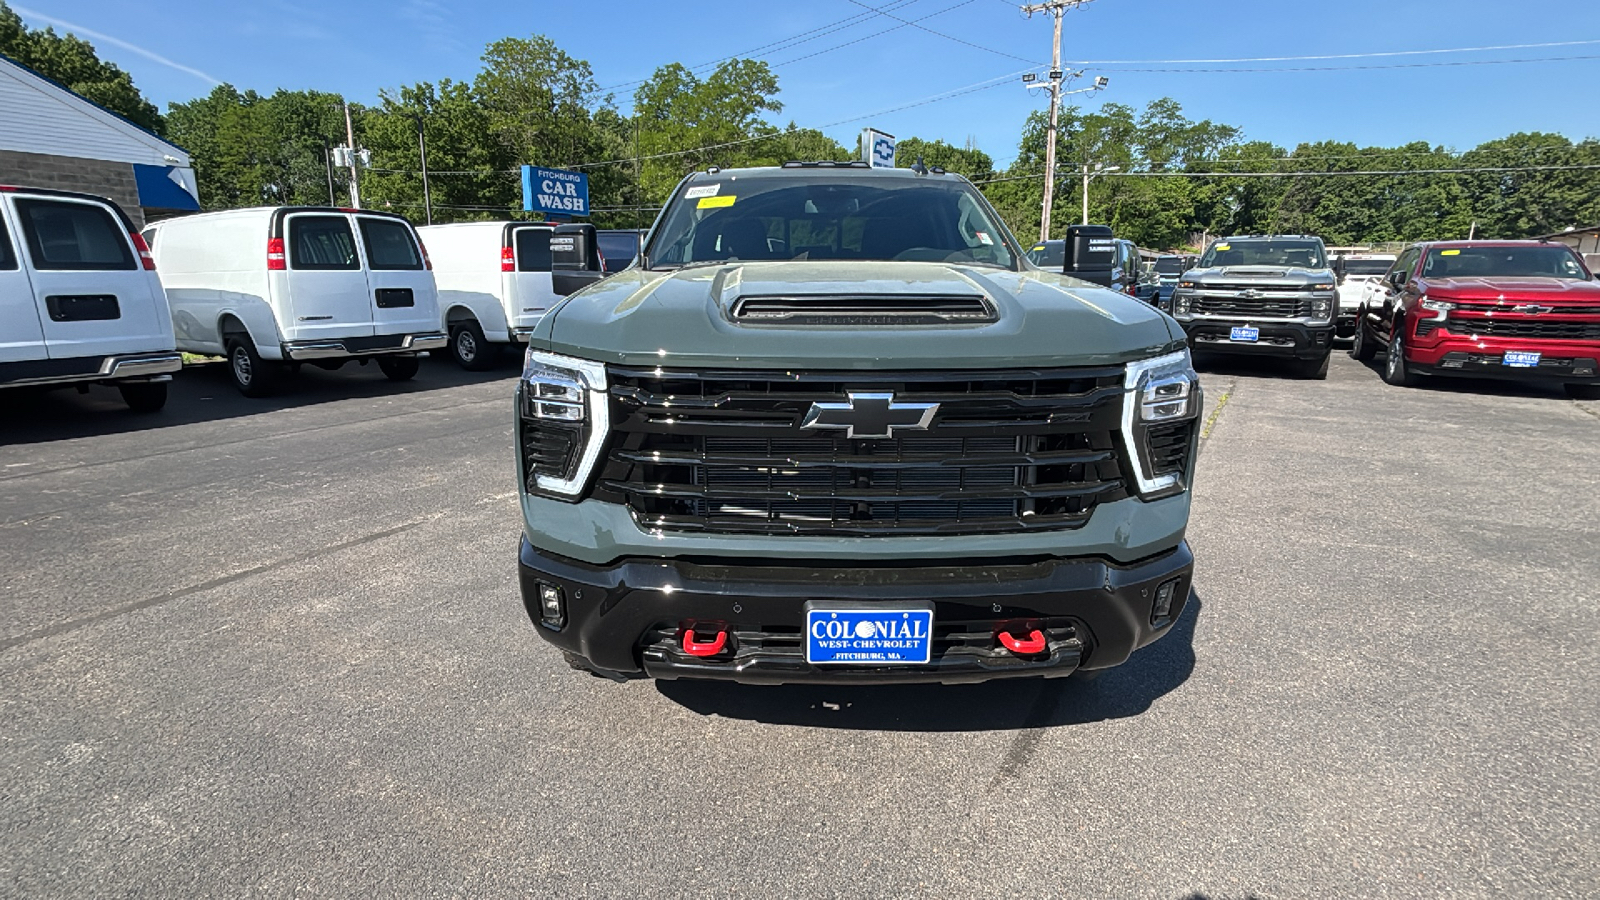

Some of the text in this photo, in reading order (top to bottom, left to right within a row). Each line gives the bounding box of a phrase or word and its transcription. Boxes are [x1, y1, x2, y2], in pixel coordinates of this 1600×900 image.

[537, 170, 581, 182] FITCHBURG
[541, 180, 577, 197] CAR
[537, 194, 584, 211] WASH
[812, 620, 926, 639] COLONIAL
[853, 640, 920, 648] CHEVROLET
[835, 652, 886, 661] FITCHBURG,
